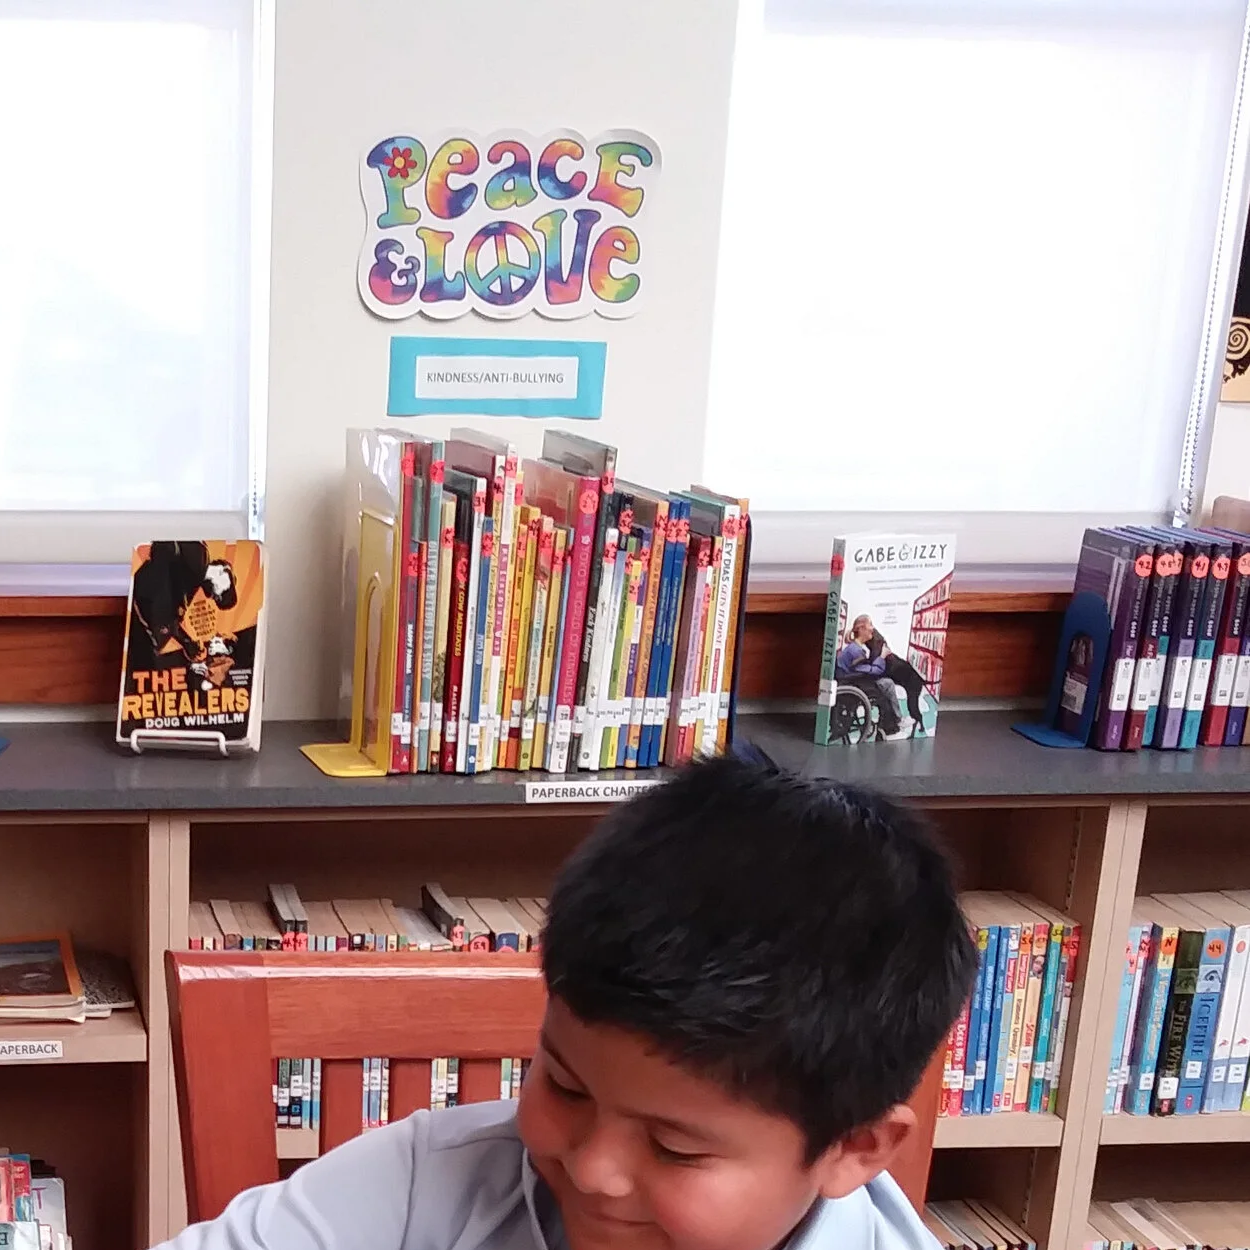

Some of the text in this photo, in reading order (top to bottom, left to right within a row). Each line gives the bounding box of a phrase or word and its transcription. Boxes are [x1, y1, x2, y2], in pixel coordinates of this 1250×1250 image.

[427, 370, 565, 385] KINDNESS/ANTI-BULLYING
[854, 547, 896, 564] GABE
[913, 543, 948, 561] IZZY
[824, 591, 838, 664] GABE IZZY
[132, 667, 188, 693] THE
[121, 688, 250, 721] REVEALERS
[145, 713, 245, 729] DOUG WILHELM
[531, 786, 600, 799] PAPERBACK
[1171, 1013, 1187, 1042] FIRE
[1190, 997, 1215, 1057] ICEFIRE
[1164, 1044, 1182, 1078] WITH
